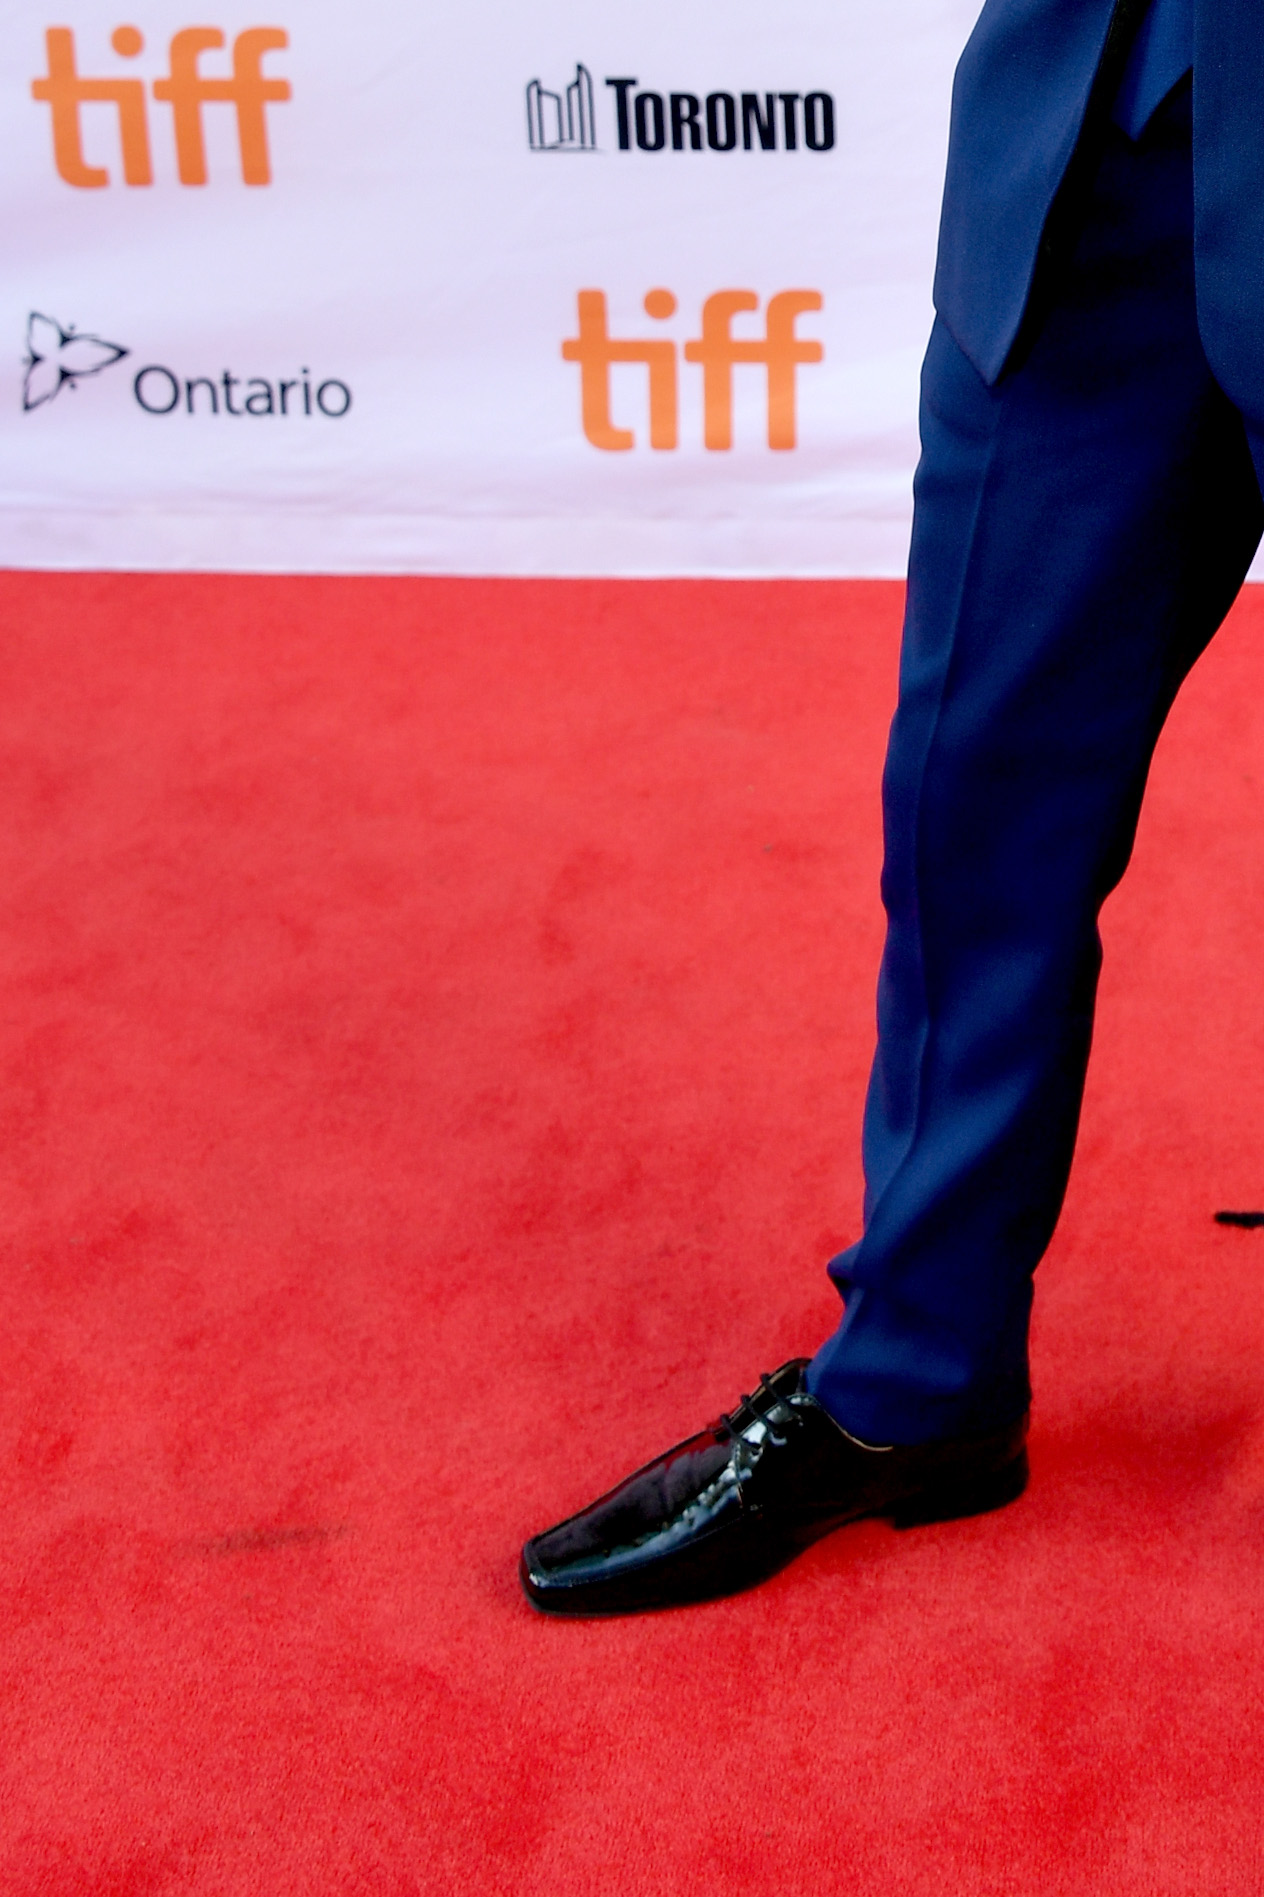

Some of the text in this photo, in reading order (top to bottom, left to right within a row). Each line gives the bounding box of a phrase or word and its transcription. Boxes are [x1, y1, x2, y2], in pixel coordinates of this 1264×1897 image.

[31, 25, 291, 189] tiff
[604, 77, 837, 152] TORONTO
[133, 365, 352, 417] Ontario
[561, 288, 823, 452] tiff
